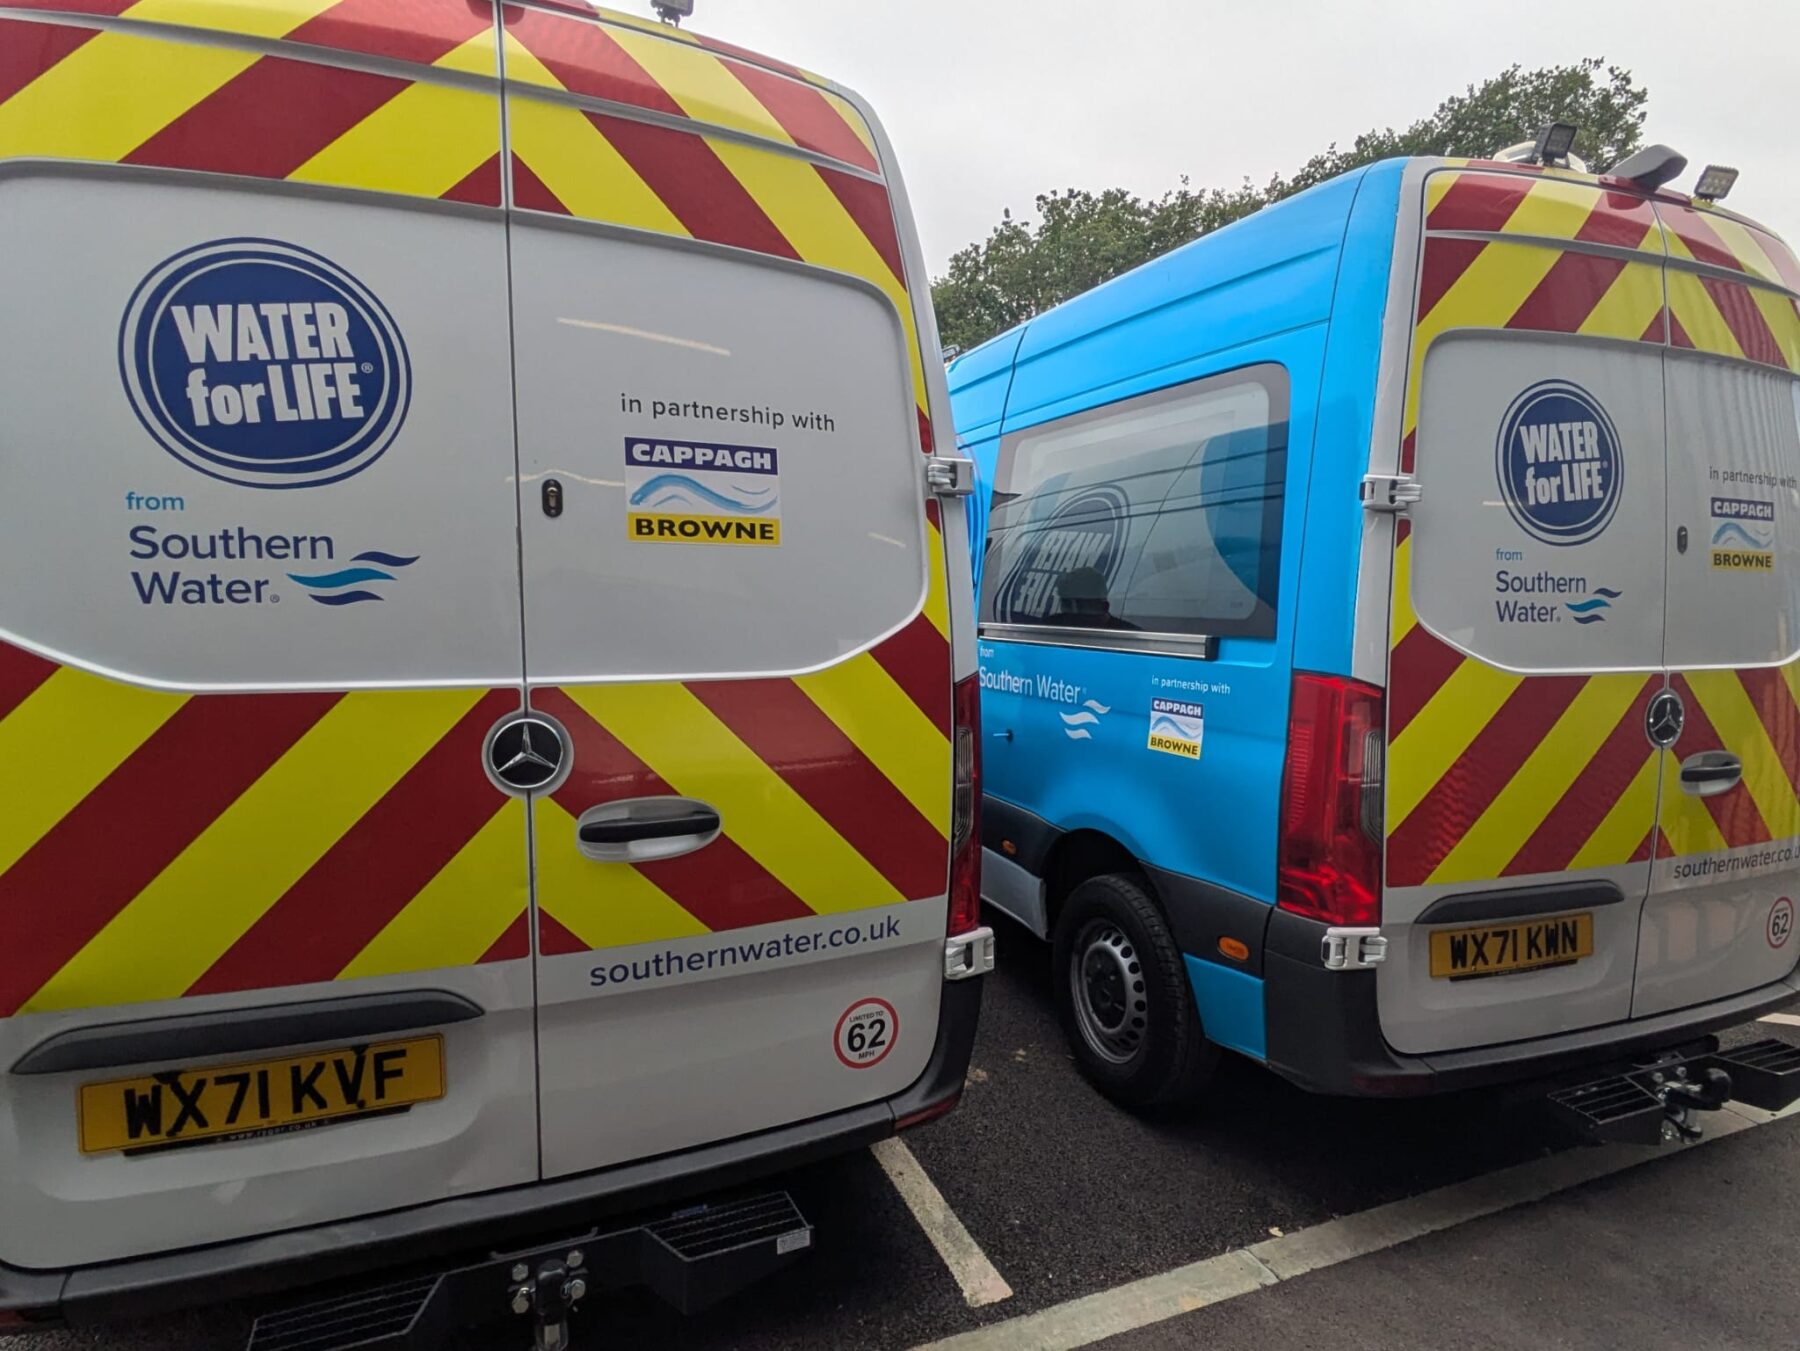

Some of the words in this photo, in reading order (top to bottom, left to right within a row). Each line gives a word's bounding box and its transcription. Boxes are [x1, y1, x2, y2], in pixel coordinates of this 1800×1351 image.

[170, 301, 354, 363] WATER
[621, 393, 642, 414] in
[652, 398, 785, 430] partnership
[792, 411, 836, 433] with
[1519, 420, 1601, 464] WATER
[631, 443, 772, 471] CAPPAGH
[1709, 465, 1719, 481] in
[1723, 470, 1778, 488] partnership
[1779, 474, 1798, 489] with
[125, 491, 185, 512] from
[1713, 501, 1772, 518] CAPPAGH
[635, 517, 774, 541] BROWNE
[129, 525, 335, 561] Southern
[1496, 548, 1523, 561] from
[1713, 553, 1772, 569] BROWNE
[131, 570, 269, 606] Water
[1496, 570, 1587, 594] Southern
[1496, 600, 1557, 624] Water
[980, 645, 995, 659] from
[979, 665, 1033, 697] Southern
[1036, 674, 1081, 705] Water
[1152, 674, 1159, 685] in
[1161, 678, 1209, 694] partnership
[1211, 682, 1231, 694] with
[1153, 700, 1202, 716] CAPPAGH
[1150, 736, 1199, 756] BROWNE
[1673, 845, 1800, 880] southernwater.co.u
[1772, 912, 1788, 937] 62
[590, 915, 901, 988] southernwater.co.uk
[1450, 928, 1518, 970] WX71
[1527, 919, 1578, 960] KWN
[849, 1012, 875, 1023] LIMITED
[847, 1018, 886, 1053] 62
[858, 1050, 875, 1060] MPH
[124, 1069, 270, 1139] WX71
[291, 1049, 407, 1115] KVF
